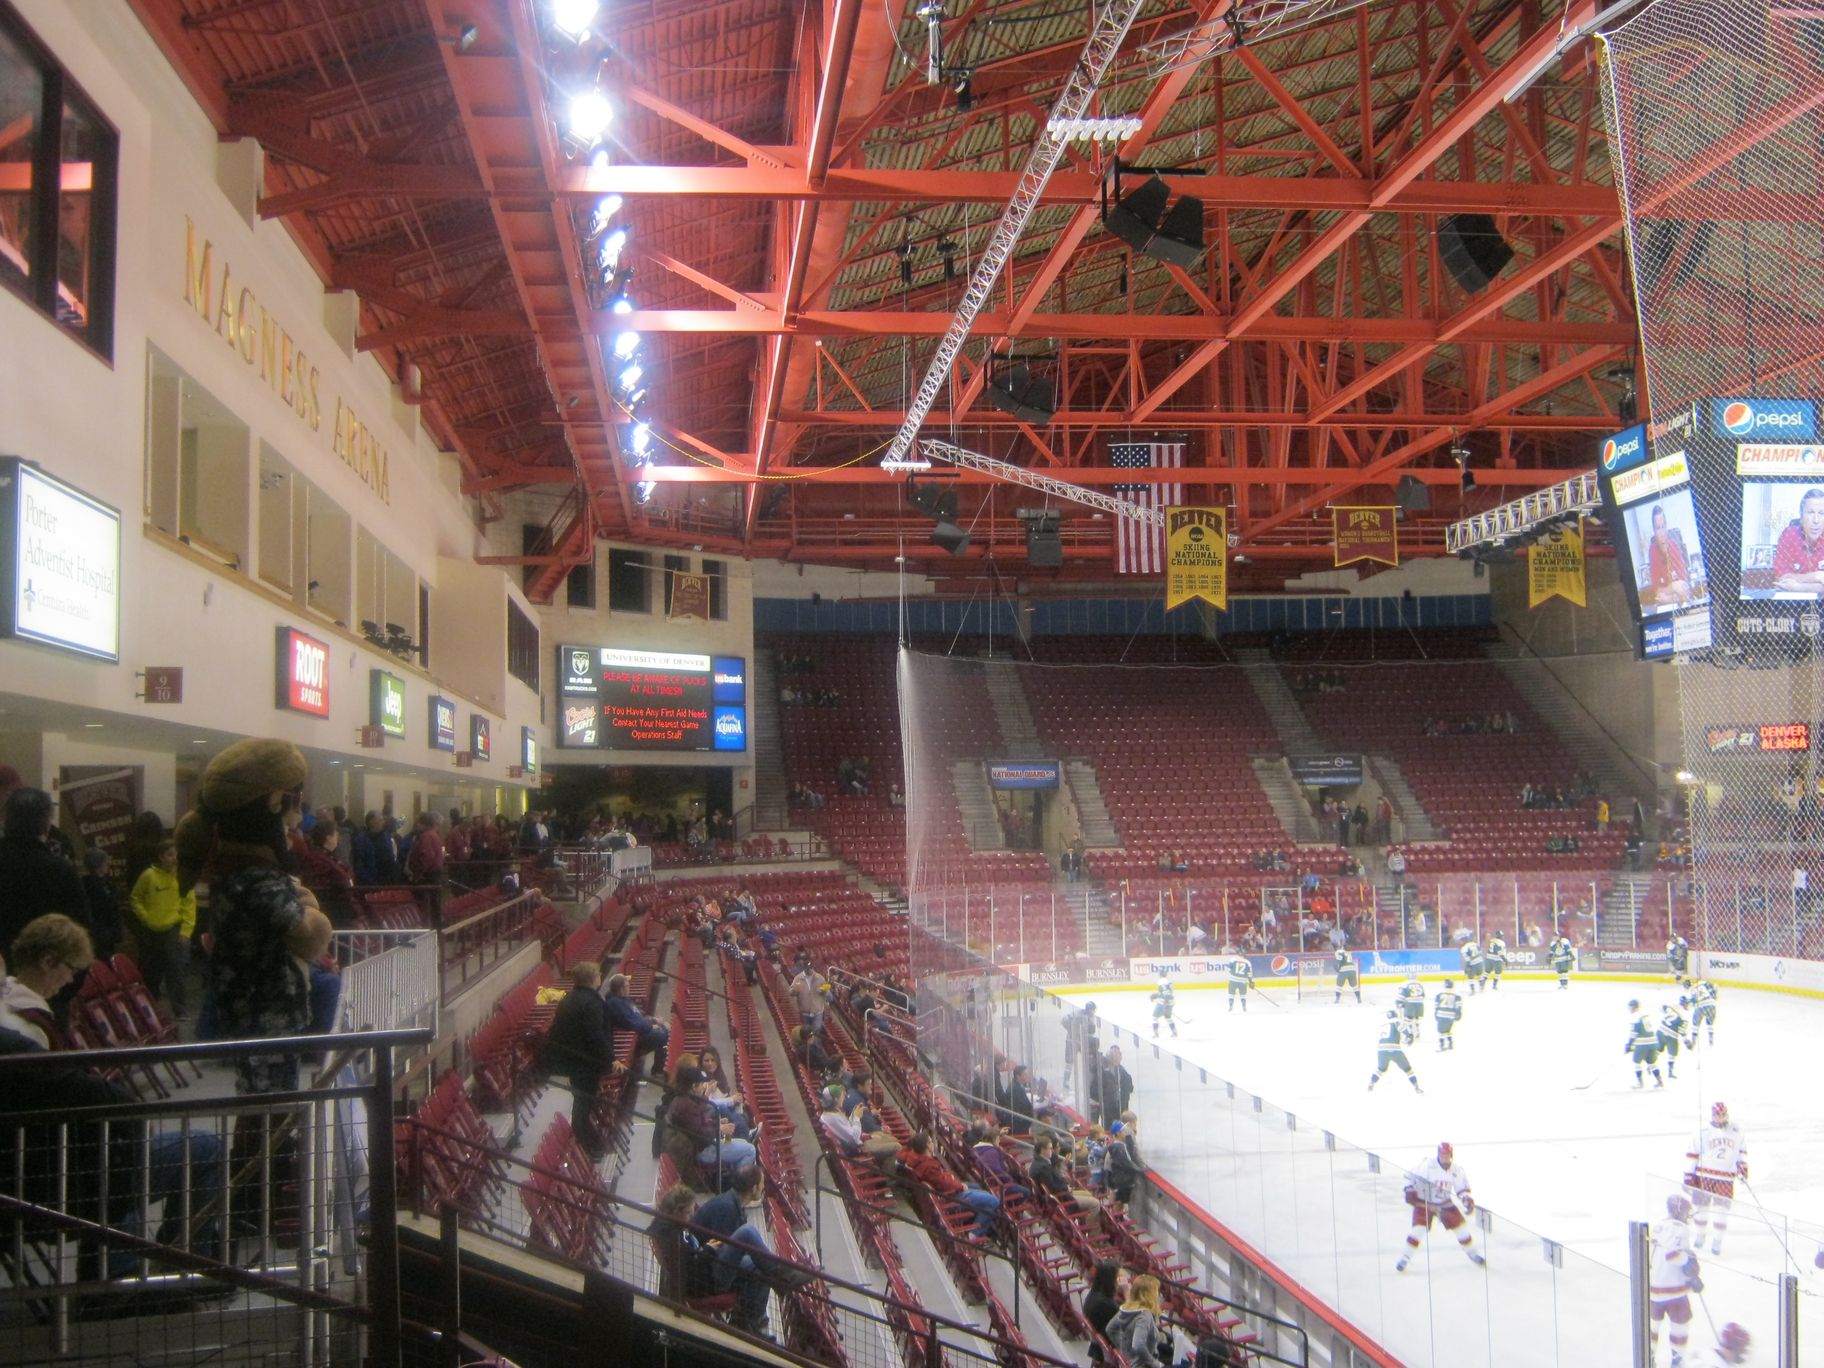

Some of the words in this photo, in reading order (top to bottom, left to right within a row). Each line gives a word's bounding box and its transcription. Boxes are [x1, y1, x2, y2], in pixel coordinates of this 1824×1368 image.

[184, 214, 320, 432] MAGNESS
[333, 397, 390, 507] ARENA
[1756, 411, 1804, 428] pepsi
[1617, 436, 1640, 460] pepsi
[26, 493, 58, 534] Porter
[1349, 510, 1381, 527] DENVER
[1170, 509, 1223, 539] DENVER
[1183, 544, 1210, 552] SKIING
[1175, 551, 1218, 559] NATIONAL
[25, 535, 74, 580] Adventist
[77, 555, 115, 599] Hospital
[1171, 558, 1223, 567] CHAMPIONS
[1533, 558, 1582, 566] CHAMPIONS
[37, 588, 66, 612] Centura
[67, 598, 89, 621] Health
[295, 639, 325, 689] ROOT
[606, 653, 659, 664] UNIVERSITY
[660, 656, 671, 664] OF
[673, 658, 705, 667] DENVER
[159, 675, 168, 687] 9
[569, 676, 593, 685] RAM
[603, 671, 631, 682] PLEASE
[632, 673, 642, 682] BE
[644, 674, 669, 684] AWARE
[671, 675, 682, 684] OF
[683, 676, 707, 686] PUCKS
[157, 689, 171, 701] 10
[630, 685, 641, 694] AT
[643, 685, 655, 695] ALL
[385, 680, 402, 724] Jeep
[565, 706, 597, 726] Coors
[604, 705, 611, 715] If
[612, 706, 625, 716] You
[626, 707, 644, 716] Have
[646, 708, 659, 719] Any
[661, 708, 674, 717] First
[676, 709, 687, 718] Aid
[688, 710, 708, 719] Needs
[569, 717, 596, 735] LIGHT
[612, 718, 638, 727] Contact
[640, 719, 654, 727] Your
[655, 720, 679, 728] Nearest
[680, 720, 700, 729] Game
[716, 718, 743, 735] AQUAFINA
[583, 730, 596, 742] 21
[631, 730, 666, 740] Operations
[667, 730, 683, 739] Staff
[1760, 725, 1807, 737] DENVER
[1761, 737, 1807, 750] ALASKA
[992, 770, 1023, 779] NATIONAL
[1024, 770, 1046, 779] GUARD
[80, 814, 133, 835] CRIMSON
[94, 833, 126, 847] CLUB
[1291, 958, 1320, 971] pepsi
[1504, 951, 1536, 965] eep
[1086, 968, 1128, 978] BURNSLEY
[1234, 961, 1246, 974] 12
[1370, 963, 1441, 973] FLYFRONTIER.COM
[1031, 971, 1069, 981] BURNSLEY
[1717, 1148, 1726, 1160] 2
[1675, 1236, 1682, 1247] 7
